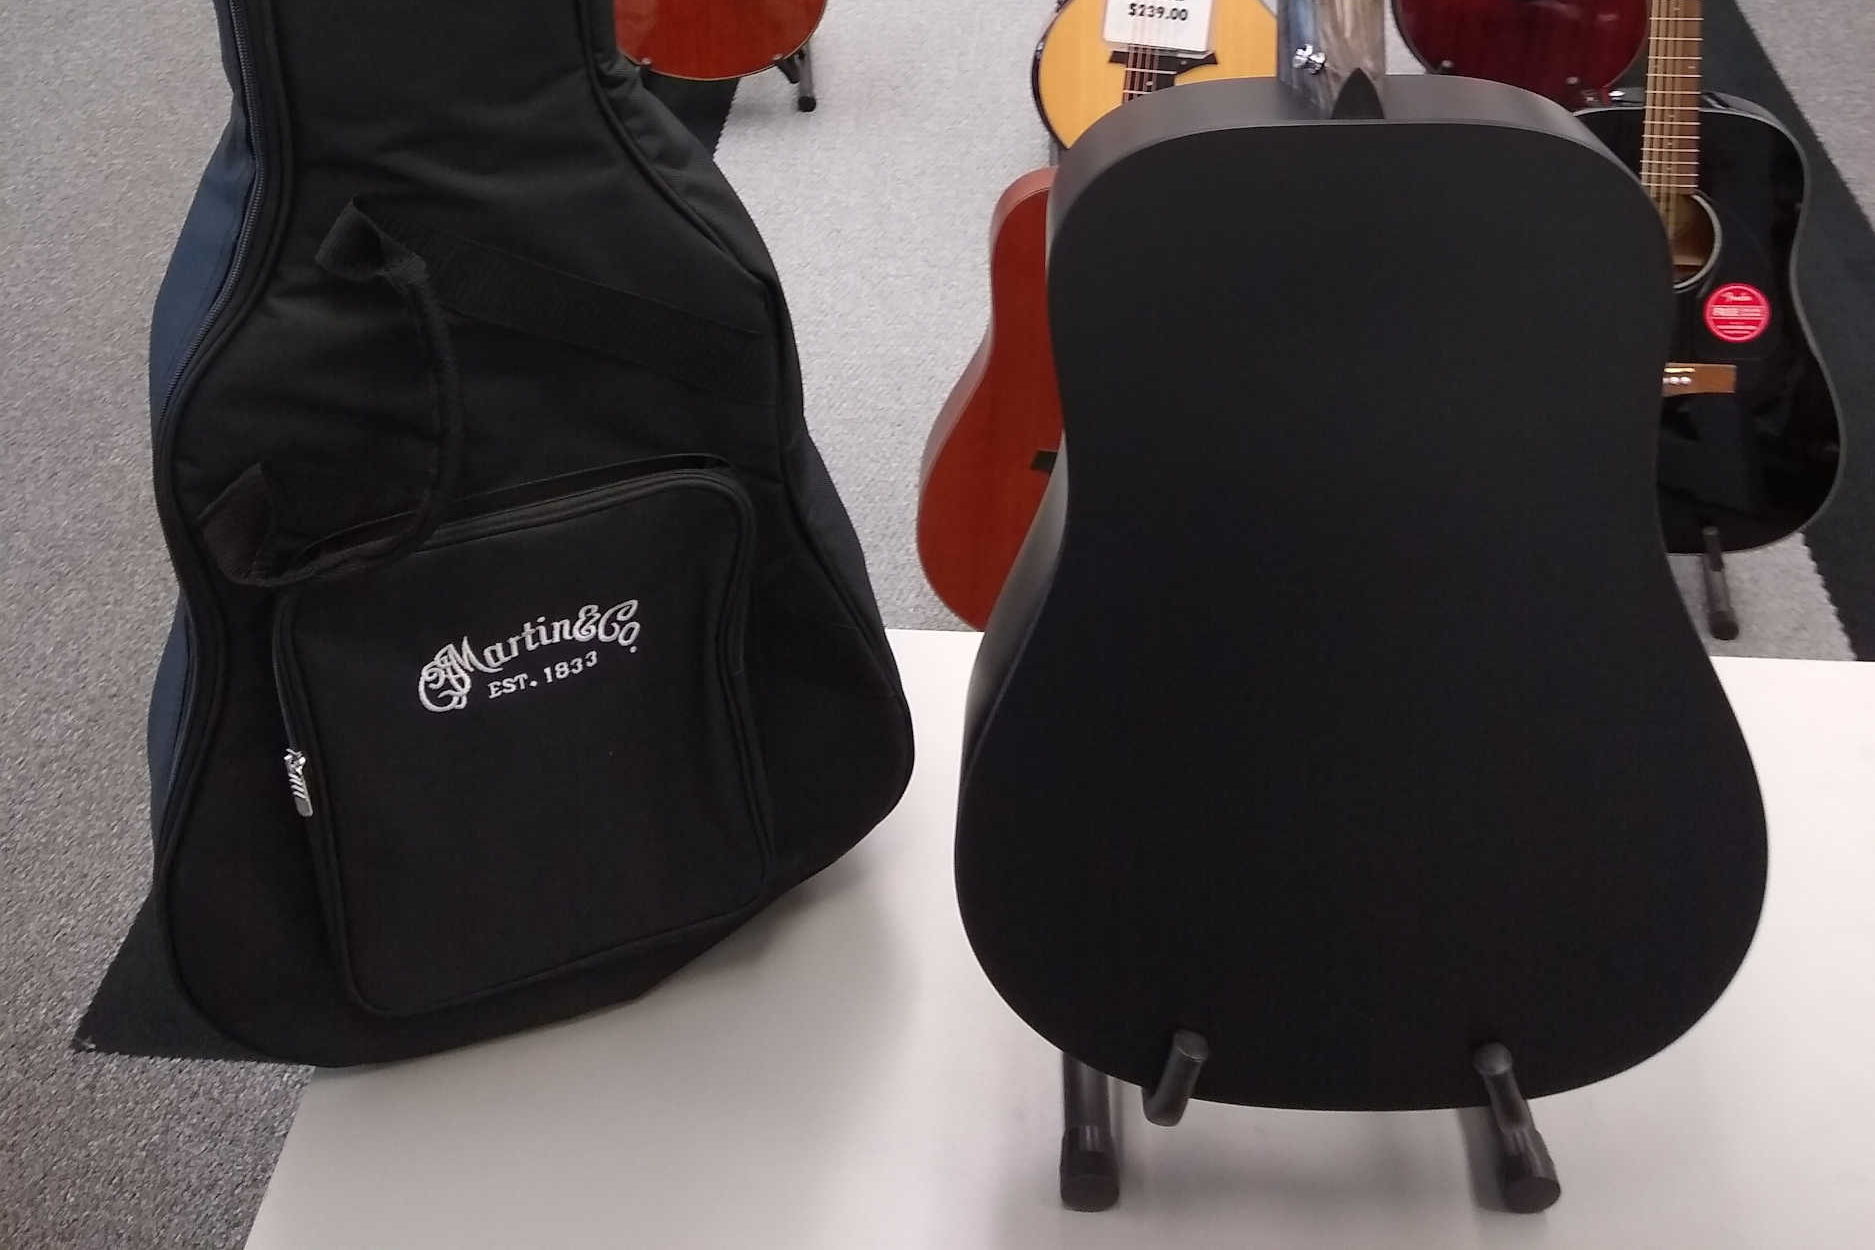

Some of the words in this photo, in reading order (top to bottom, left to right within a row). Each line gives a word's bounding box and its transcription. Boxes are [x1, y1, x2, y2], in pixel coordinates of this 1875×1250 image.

[1128, 3, 1190, 21] $239.00
[487, 674, 538, 699] EST.
[543, 650, 598, 683] 1833
